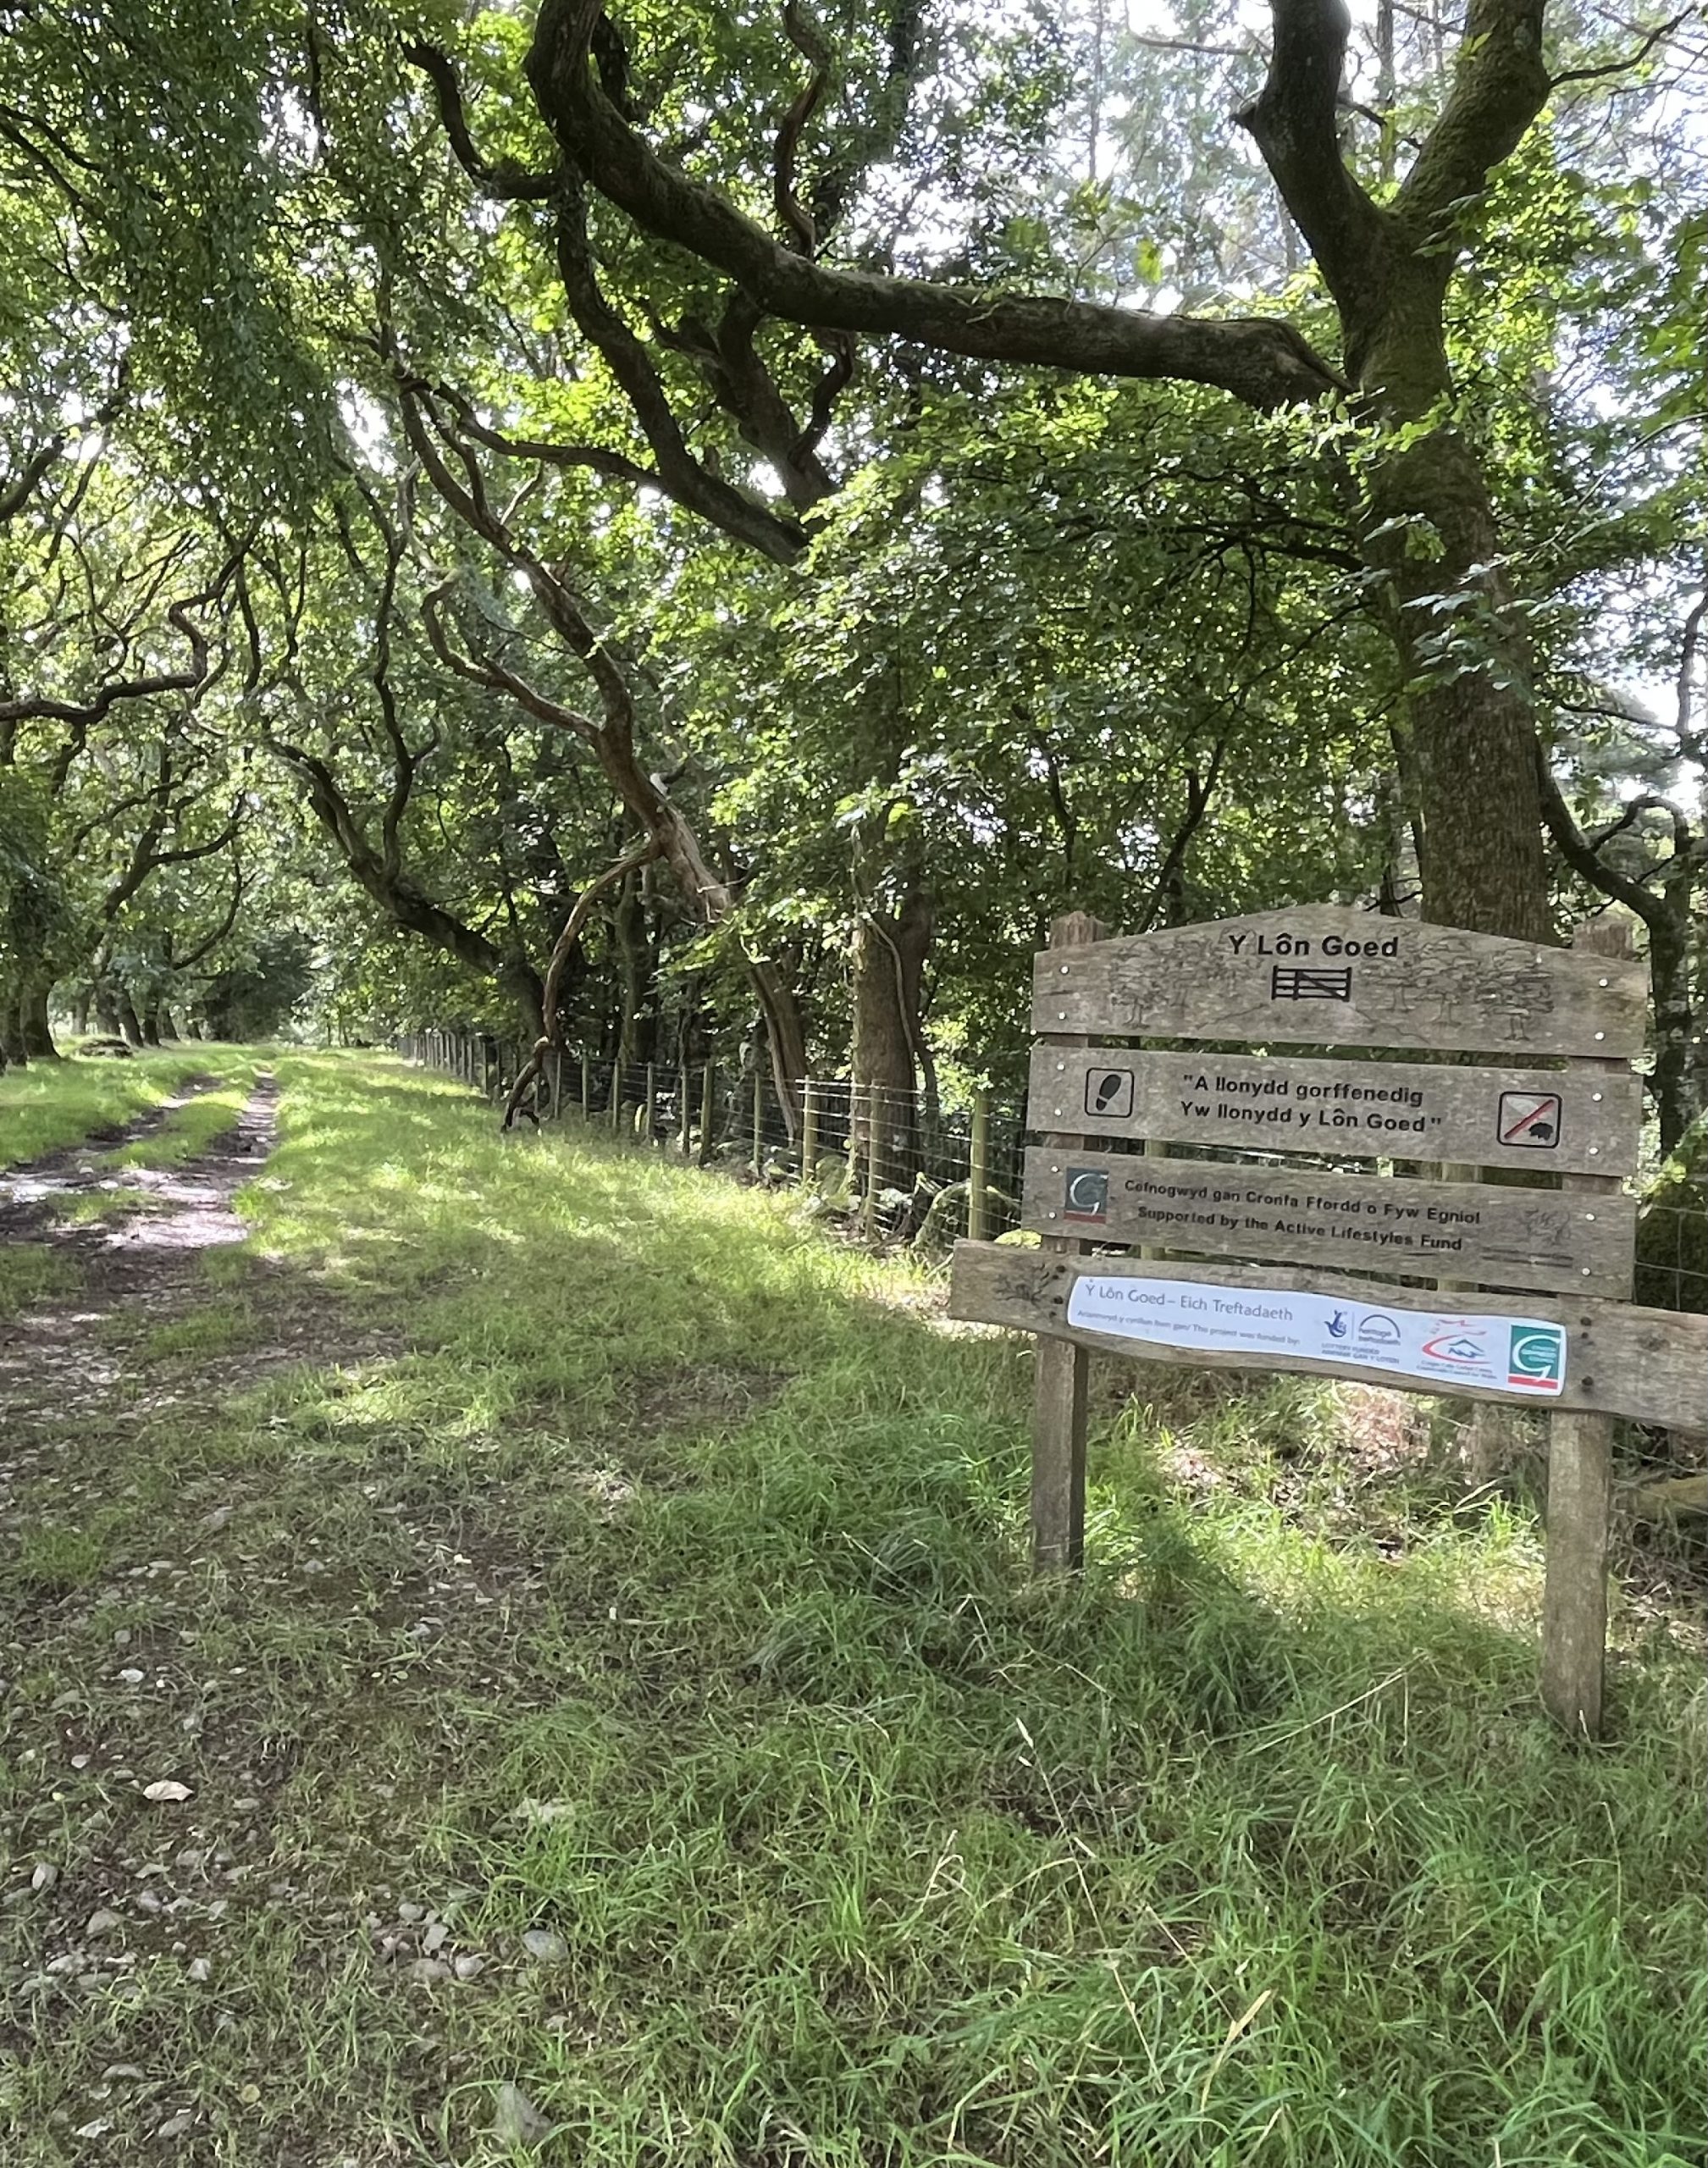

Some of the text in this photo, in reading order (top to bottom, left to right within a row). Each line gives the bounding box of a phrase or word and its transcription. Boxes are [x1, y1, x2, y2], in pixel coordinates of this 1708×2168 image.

[1229, 932, 1398, 957] Y Lôn Goed
[1215, 1076, 1289, 1098] llonydd
[1296, 1083, 1423, 1108] gorffenedig
[1180, 1101, 1210, 1116] Yw
[1218, 1103, 1292, 1124] llonydd
[1299, 1112, 1311, 1127] y
[1319, 1108, 1358, 1127] Lôn
[1125, 1180, 1208, 1199] Cefnogwyd
[1213, 1189, 1240, 1203] gan
[1246, 1192, 1298, 1207] Cronfa
[1307, 1196, 1361, 1214] Ffordd
[1367, 1204, 1377, 1214] o
[1384, 1203, 1419, 1220] Fyw
[1138, 1207, 1462, 1251] Supported by the Active Lifestyles Fund
[1100, 1286, 1124, 1301] Lôn
[1128, 1289, 1165, 1305] Goed
[1180, 1295, 1208, 1311] Eich
[1213, 1299, 1293, 1321] Treftadaeth
